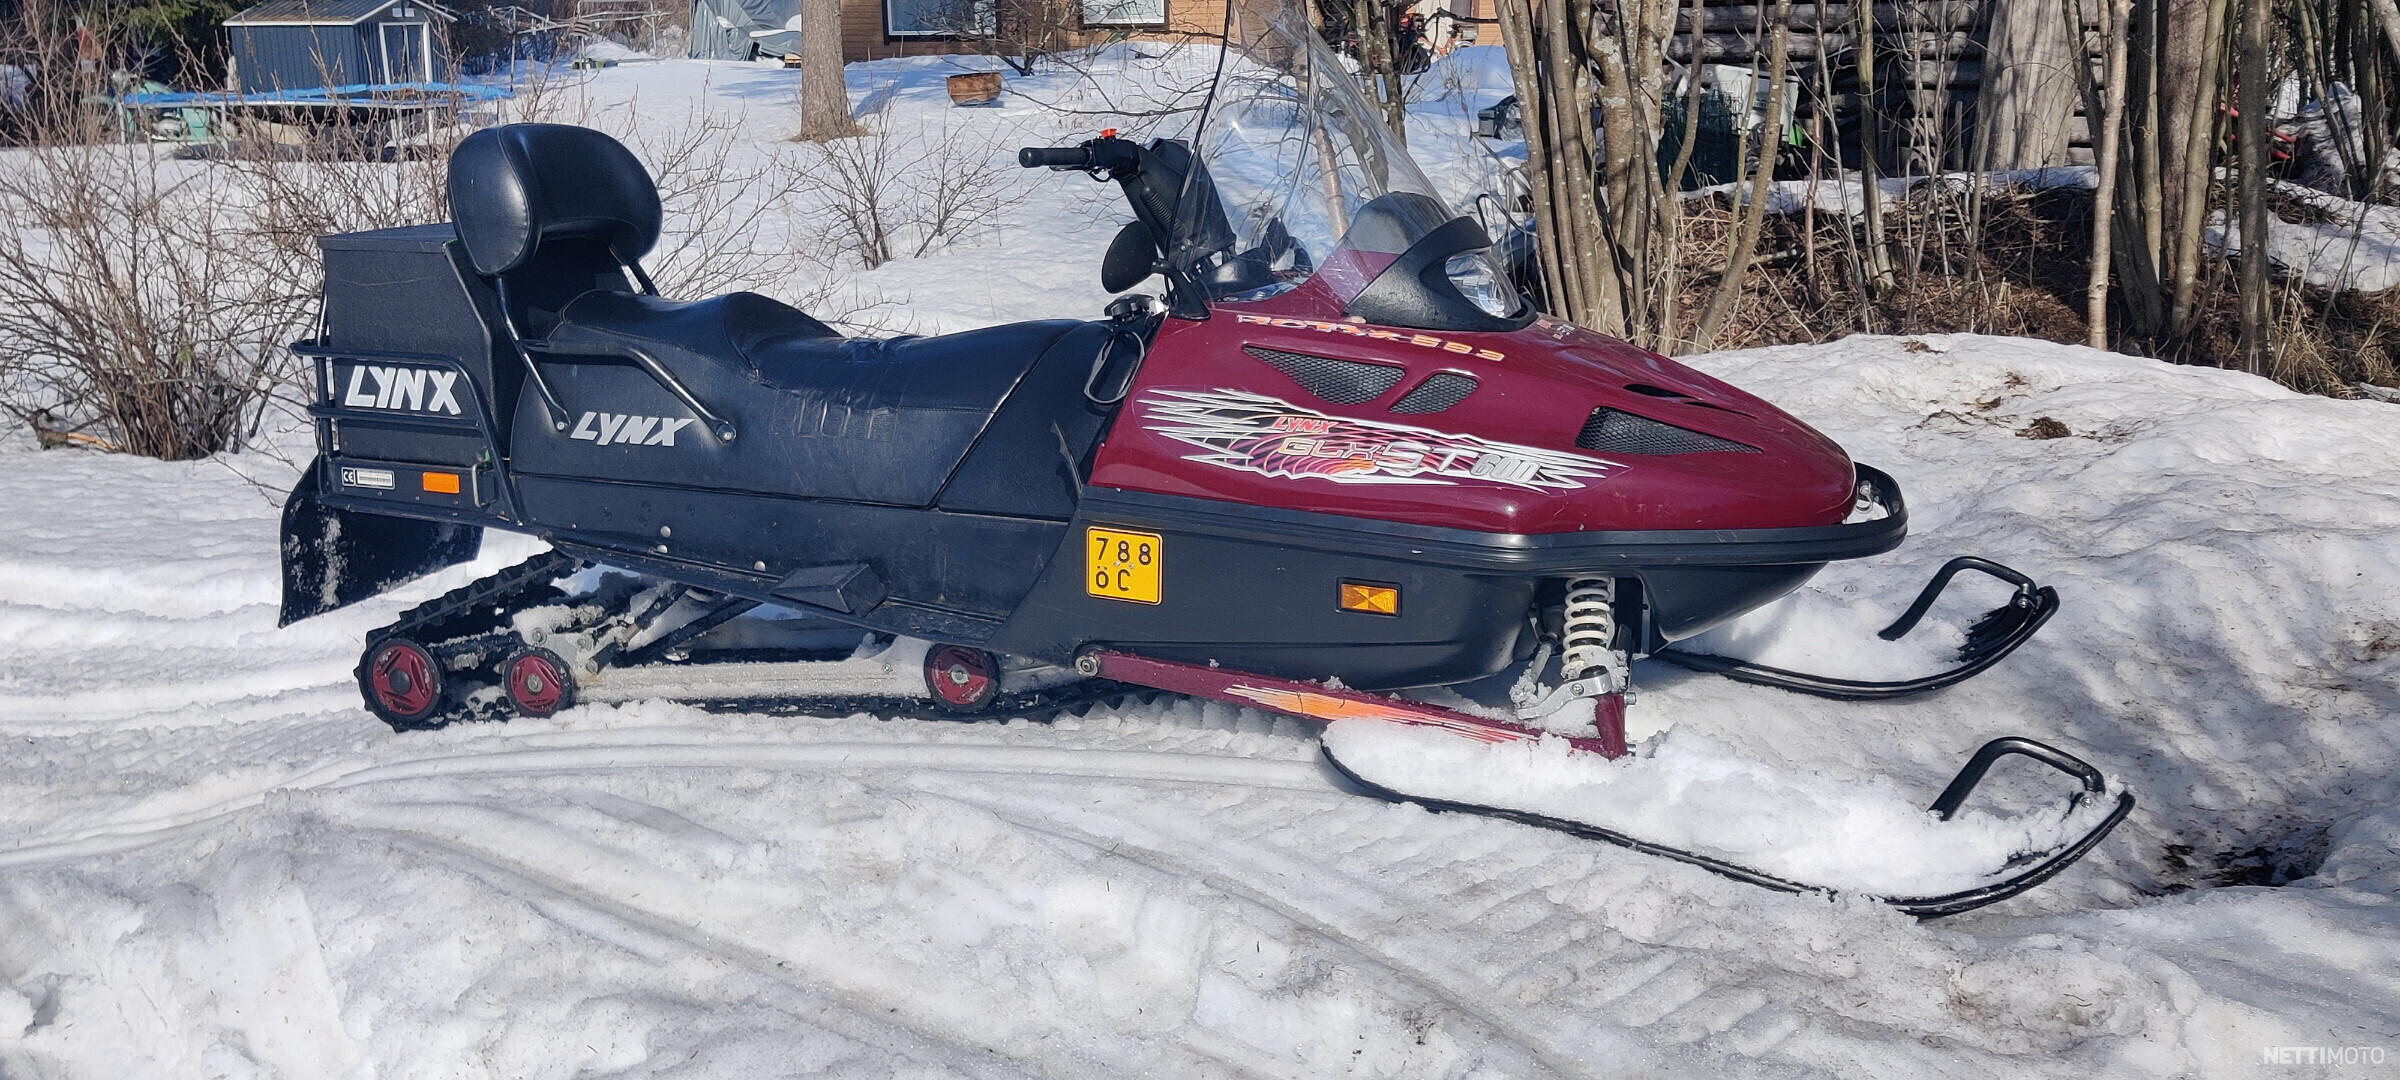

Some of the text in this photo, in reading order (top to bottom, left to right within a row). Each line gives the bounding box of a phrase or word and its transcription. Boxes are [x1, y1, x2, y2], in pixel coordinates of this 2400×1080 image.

[344, 365, 462, 415] LYNX
[570, 411, 696, 447] LYNX
[1271, 416, 1339, 434] LYNX
[1469, 453, 1541, 484] 600
[1096, 537, 1152, 566] 788
[1095, 565, 1131, 592] ÖC
